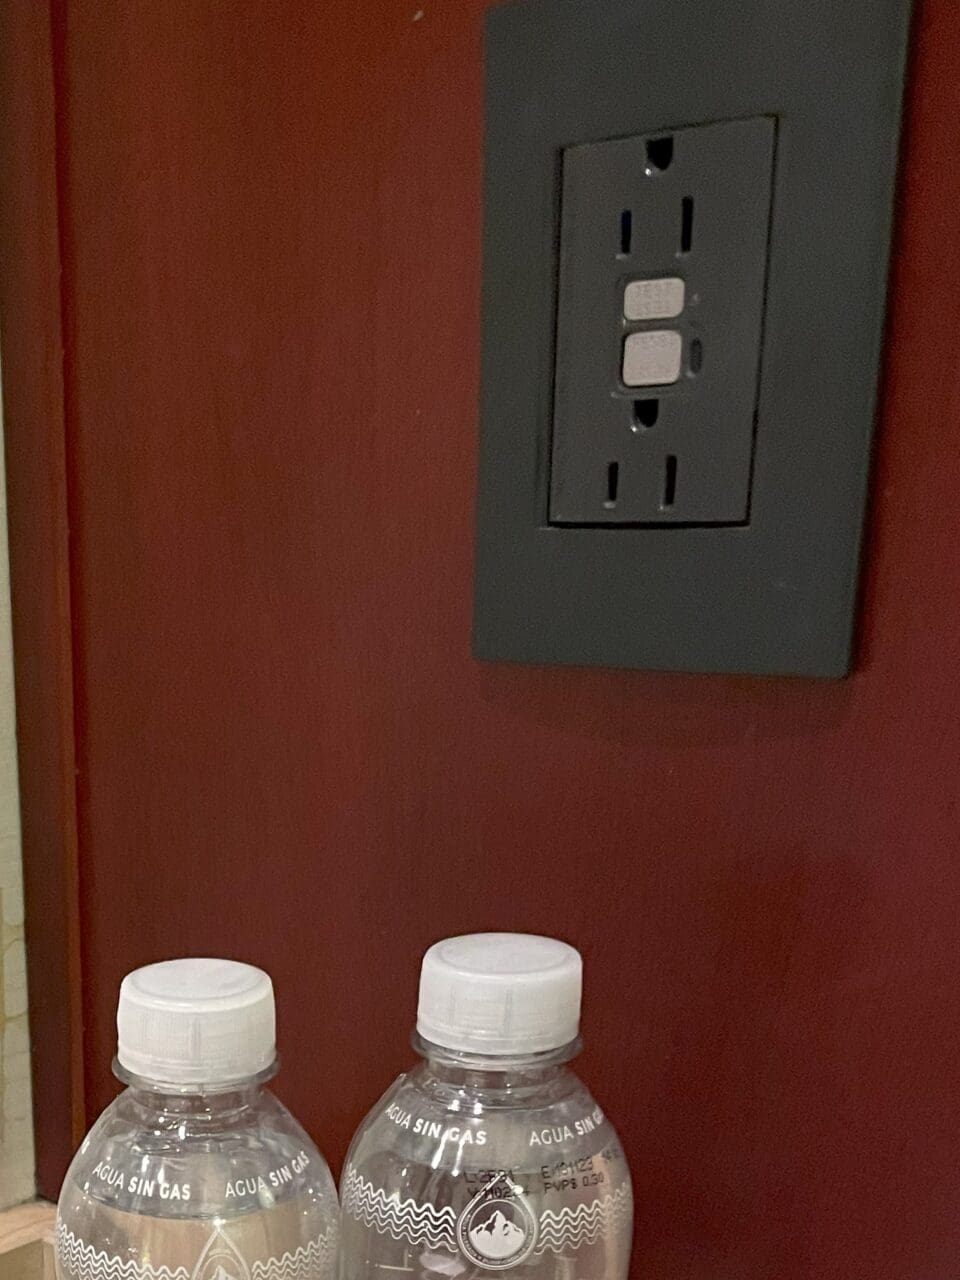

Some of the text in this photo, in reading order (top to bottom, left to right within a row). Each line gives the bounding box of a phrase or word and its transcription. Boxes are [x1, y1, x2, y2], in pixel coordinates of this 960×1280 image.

[385, 1102, 487, 1145] AGUA SIN GAS
[529, 1125, 574, 1146] AGUA
[574, 1116, 596, 1135] SIN
[92, 1161, 190, 1200] AGUA SIN GAS
[225, 1150, 310, 1199] AGUA SIN GAS
